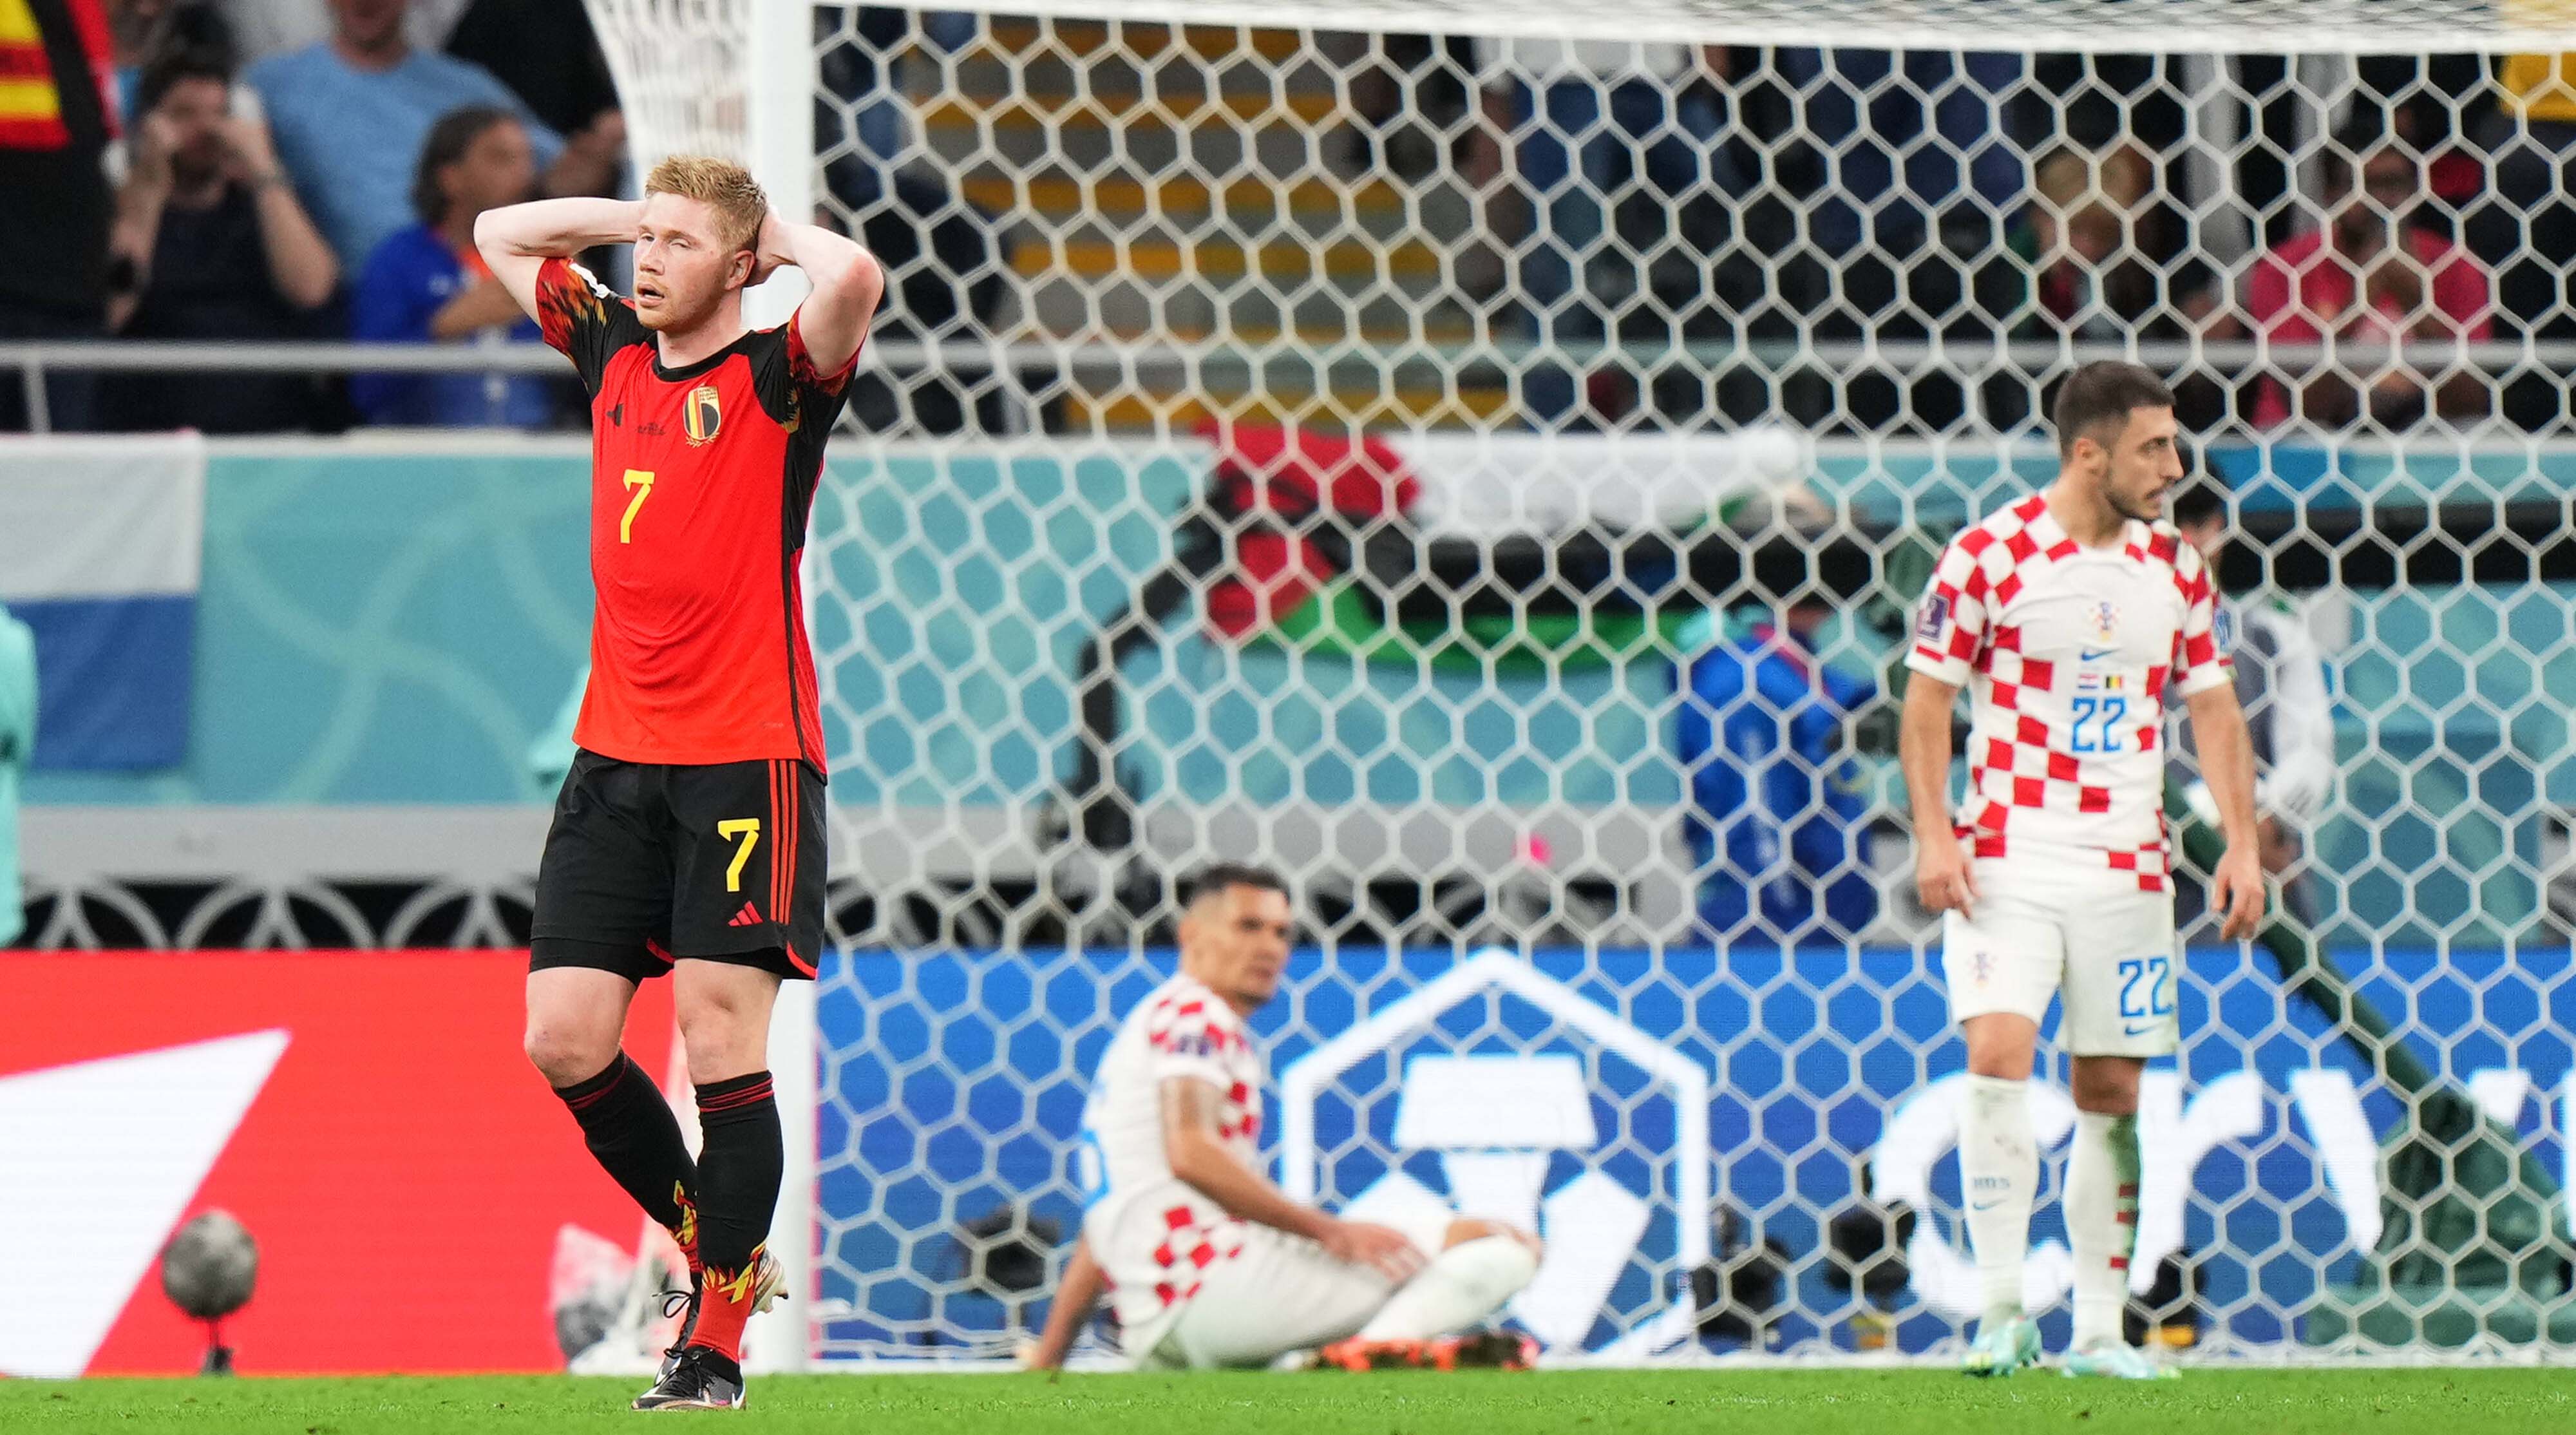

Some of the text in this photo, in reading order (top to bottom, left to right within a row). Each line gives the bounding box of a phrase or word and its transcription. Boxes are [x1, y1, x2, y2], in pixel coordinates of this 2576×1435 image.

[620, 468, 655, 544] 7
[2070, 696, 2127, 753] 22
[717, 817, 761, 892] 7
[2118, 955, 2175, 1018] 22
